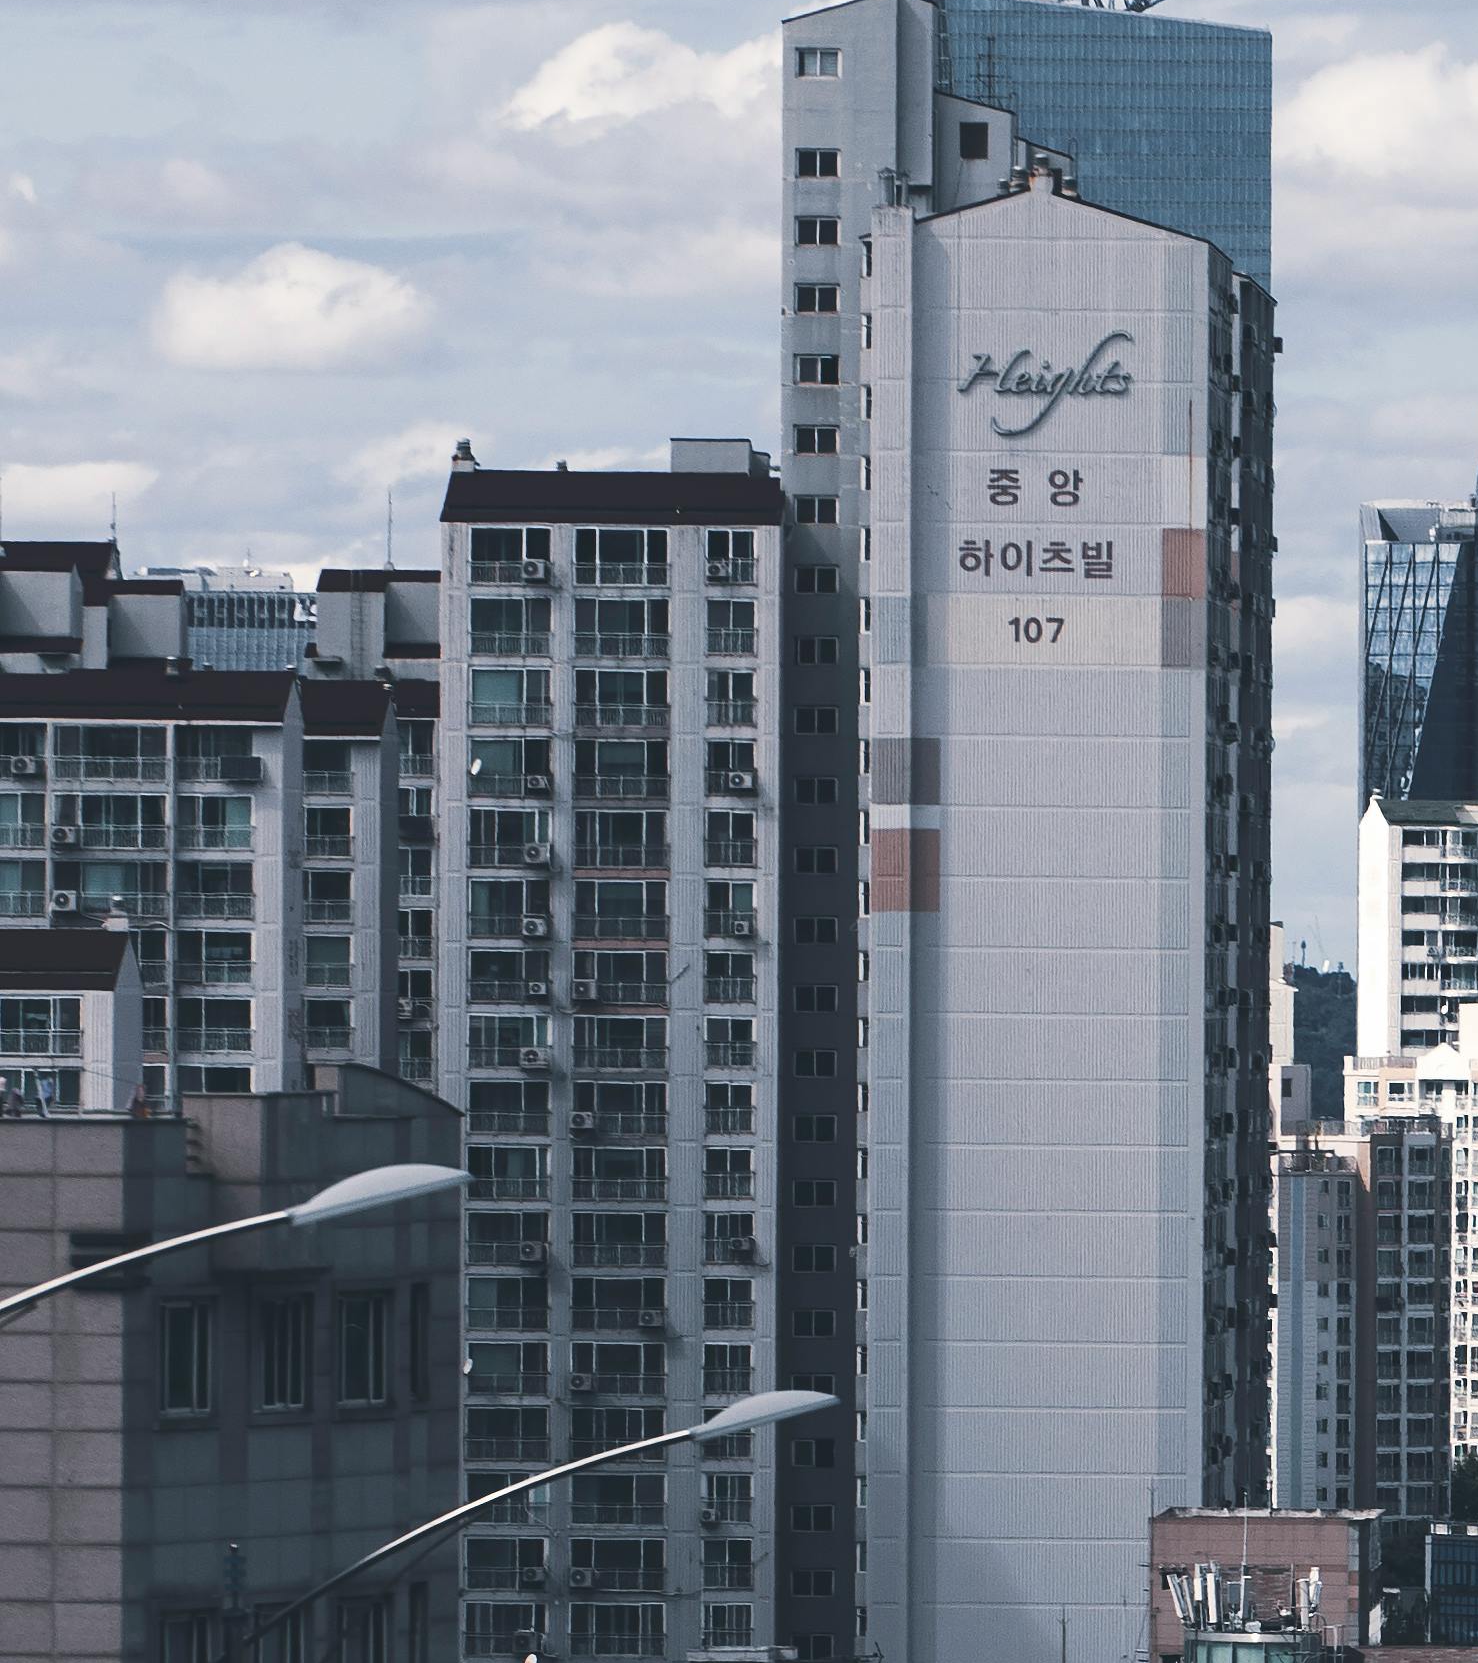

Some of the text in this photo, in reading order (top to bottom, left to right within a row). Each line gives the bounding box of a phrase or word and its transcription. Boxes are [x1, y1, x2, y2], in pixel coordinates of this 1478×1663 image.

[958, 331, 1133, 437] Heights
[988, 468, 1083, 506] 중앙
[959, 539, 1114, 579] 하이츠빌
[1008, 617, 1064, 643] 107
